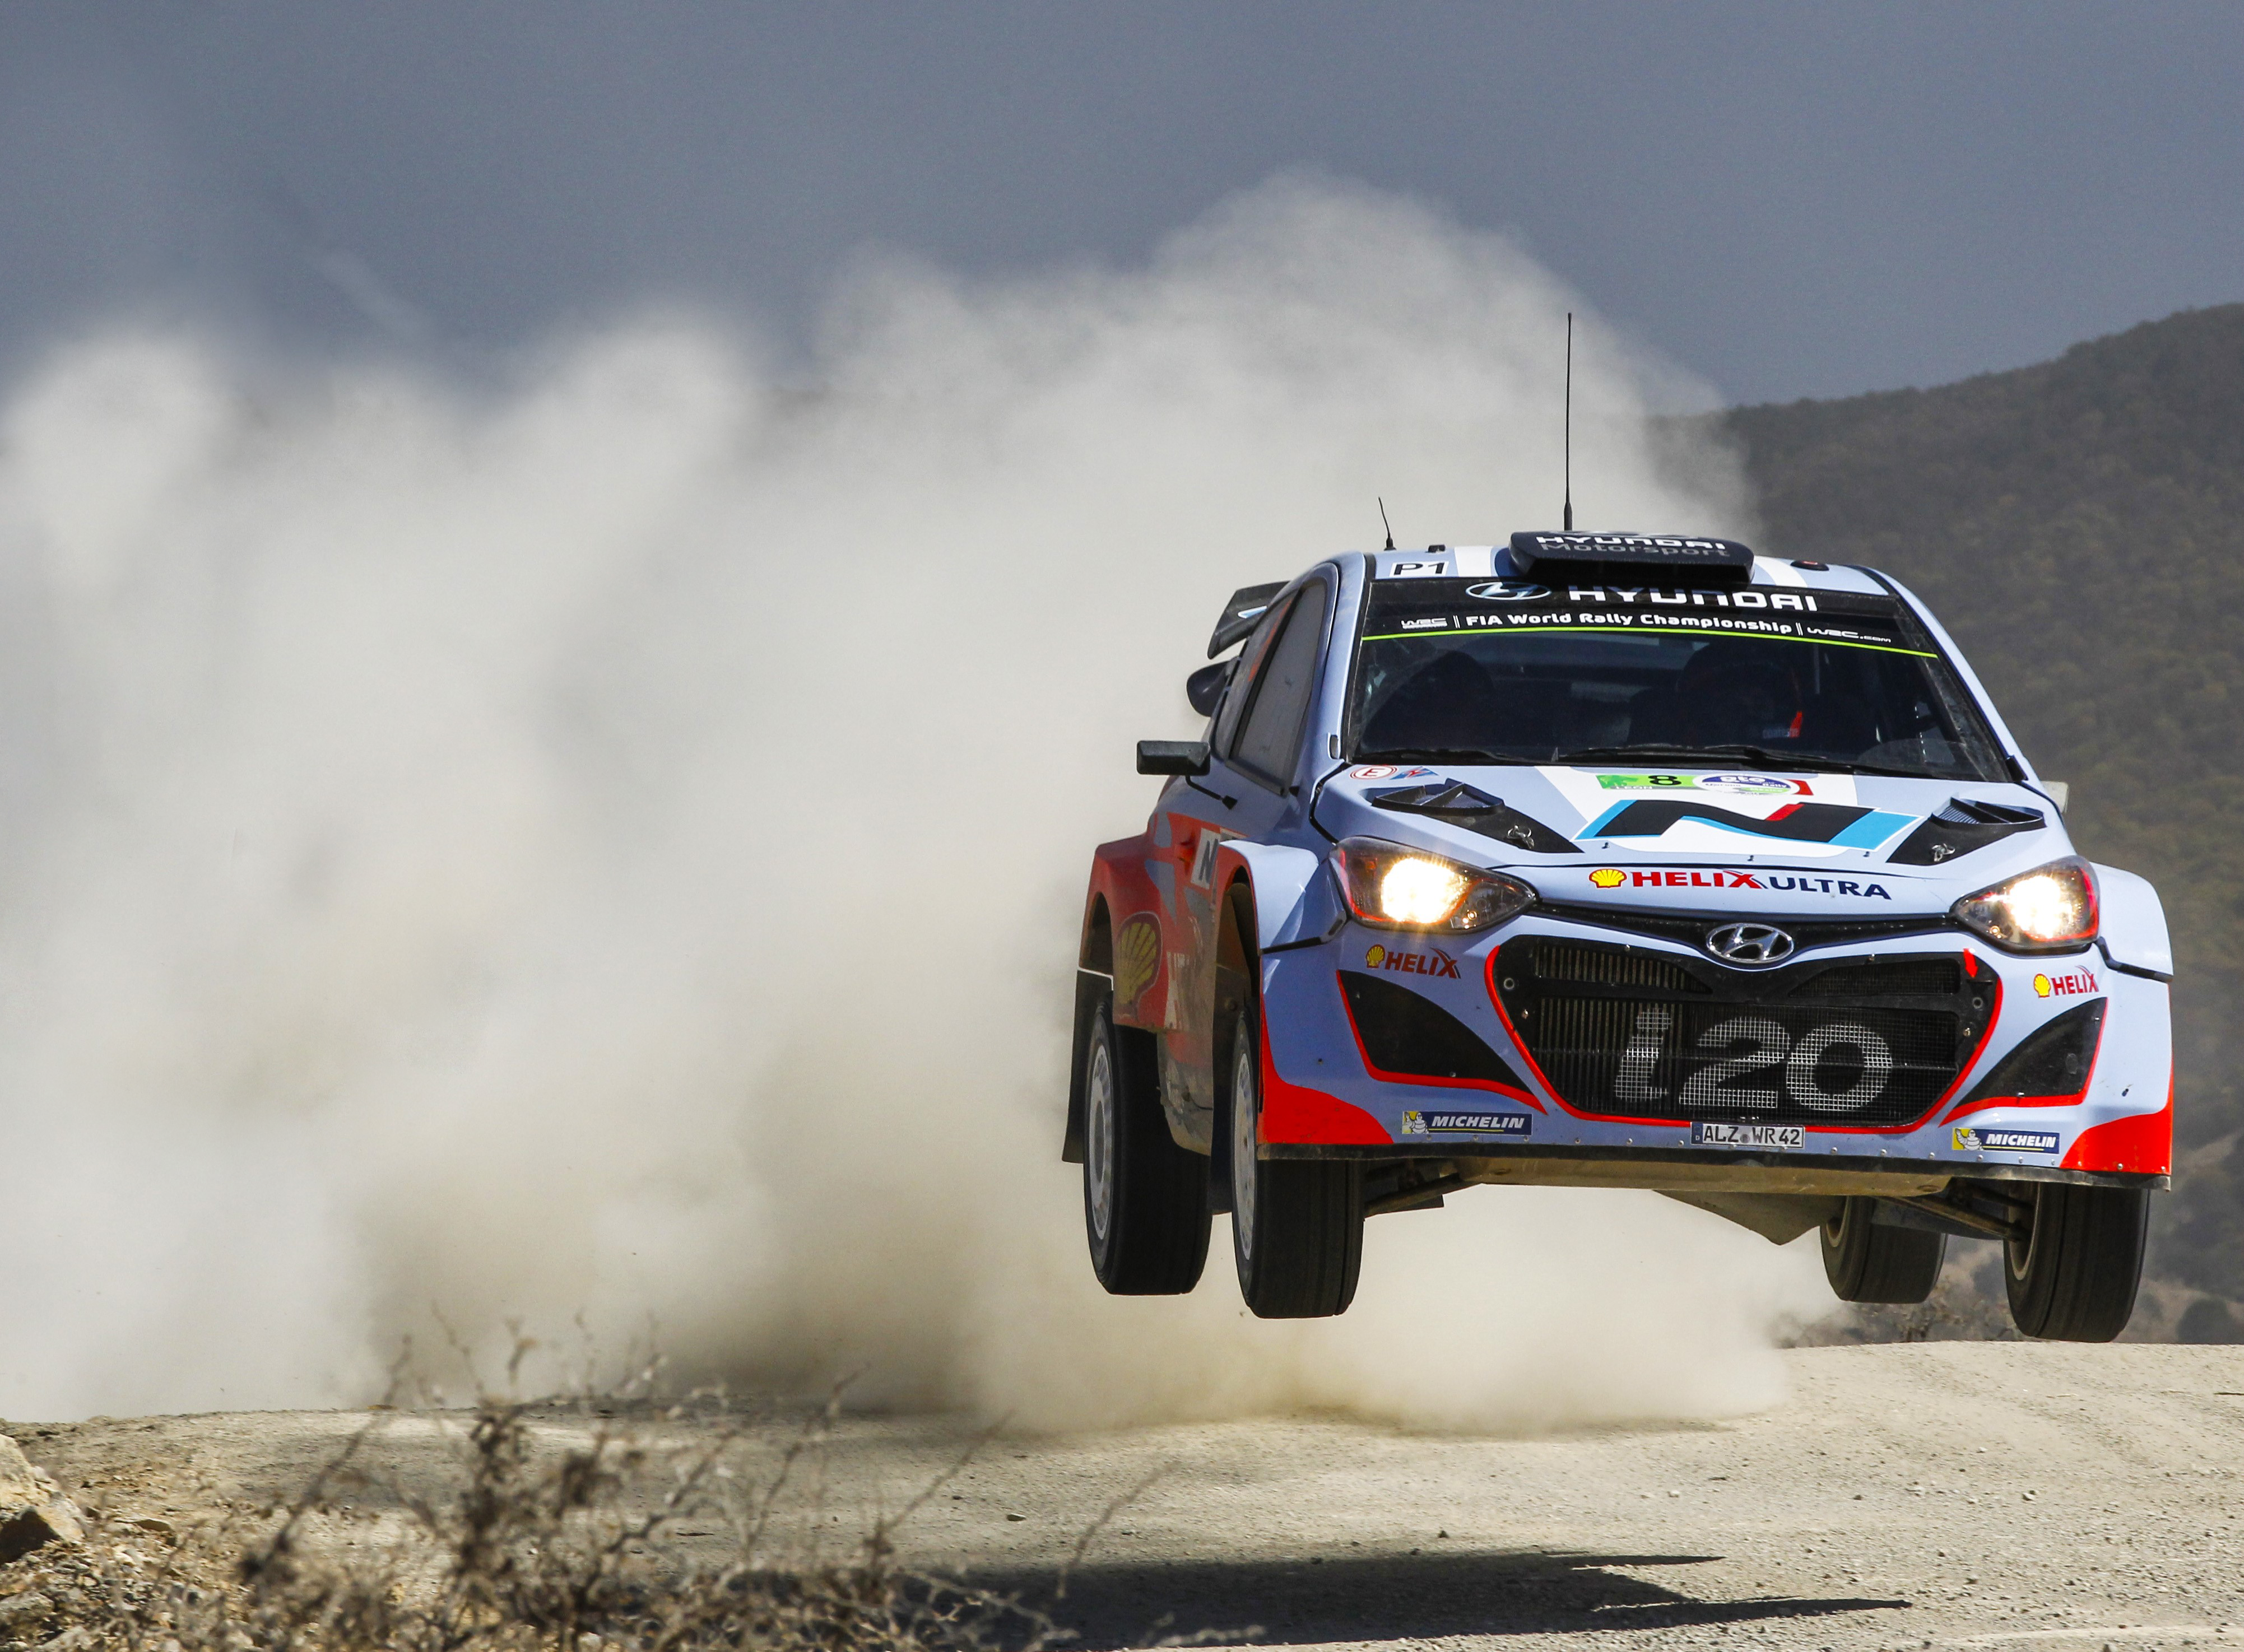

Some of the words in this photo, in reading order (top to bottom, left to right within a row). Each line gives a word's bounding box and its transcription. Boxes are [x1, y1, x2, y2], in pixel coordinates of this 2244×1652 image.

[1536, 536, 1726, 550] HYUNDAI
[1541, 543, 1730, 557] Motorsport
[1393, 562, 1445, 575] P1
[1568, 585, 1818, 612] HYUNDAI
[1466, 615, 1503, 626] FIA
[1507, 613, 1572, 625] World
[1578, 613, 1633, 626] Rally
[1639, 614, 1792, 635] Championship
[1362, 768, 1386, 776] E
[1648, 775, 1682, 786] 8
[1631, 869, 1768, 890] HELIX
[1769, 876, 1892, 900] ULTRA
[1385, 947, 1461, 979] HELIX
[2051, 965, 2099, 995] HELIX
[1614, 1012, 1892, 1111] i20
[1432, 1115, 1525, 1129] MICHELIN
[1704, 1125, 1739, 1143] ALZ
[1986, 1133, 2057, 1148] MICHELIN
